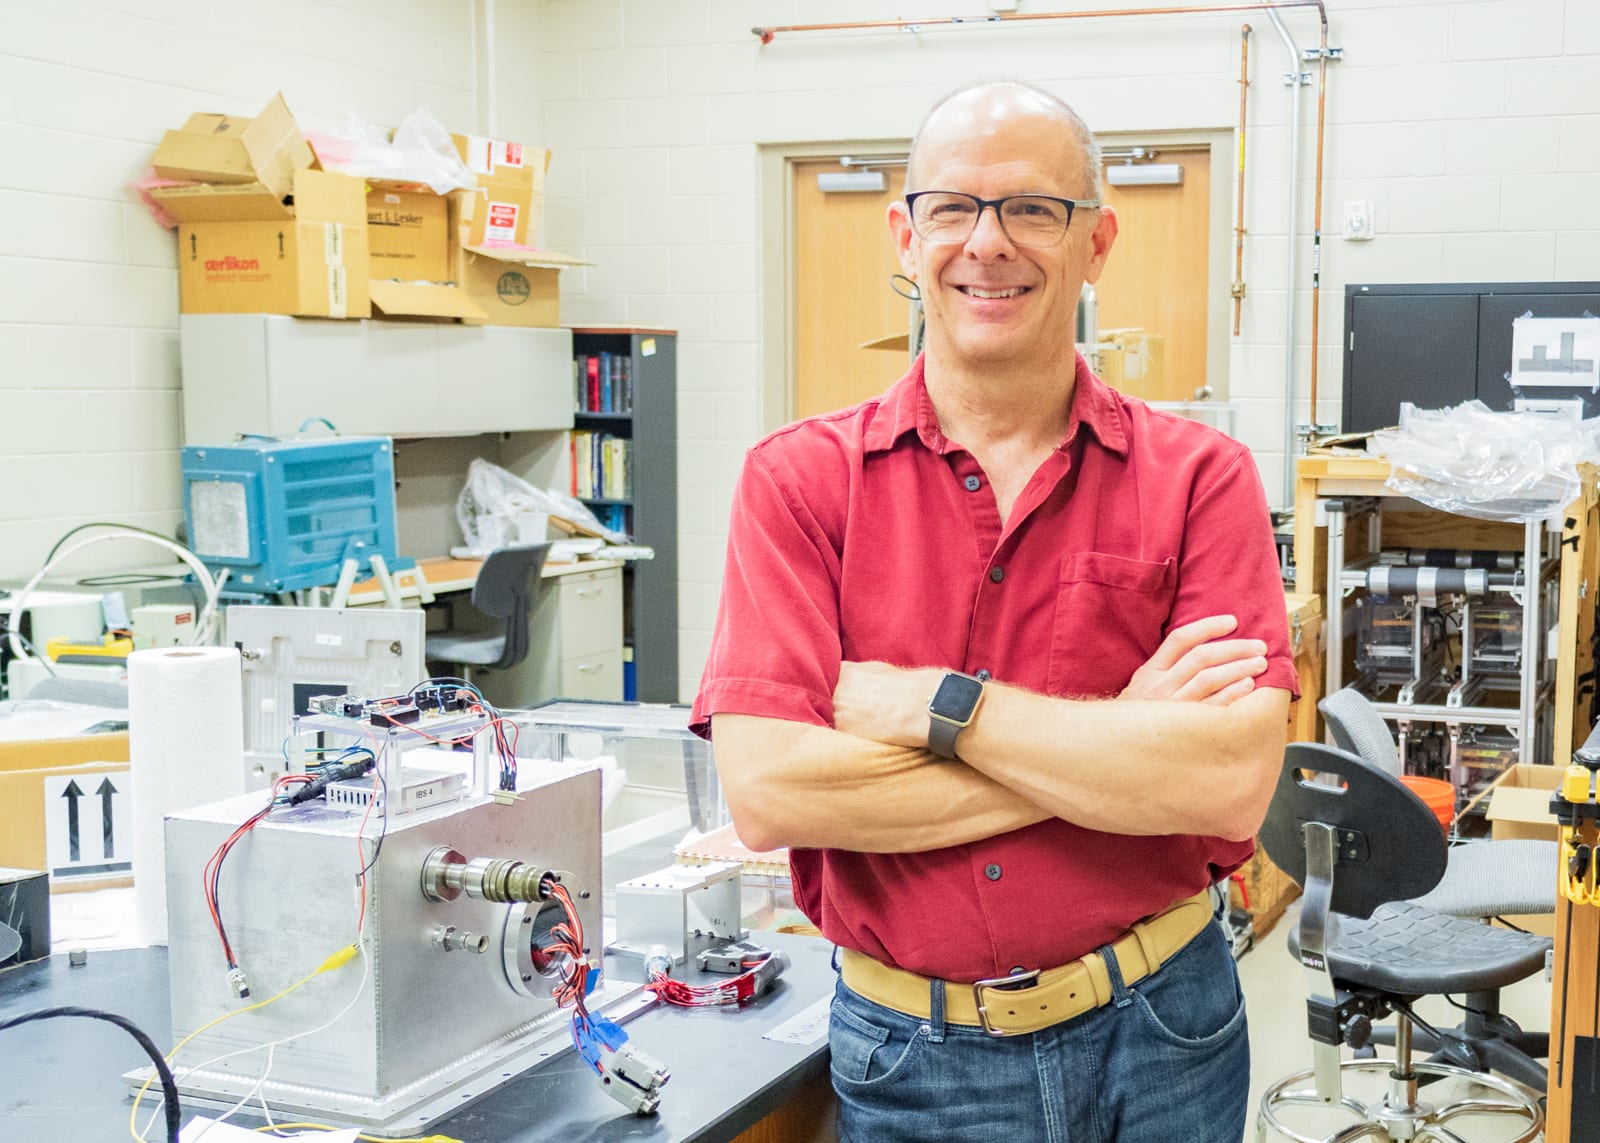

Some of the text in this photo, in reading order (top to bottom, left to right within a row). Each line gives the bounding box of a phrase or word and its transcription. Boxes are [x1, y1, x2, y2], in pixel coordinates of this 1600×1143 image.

[394, 211, 424, 225] Lesker
[415, 788, 433, 800] IBS 4
